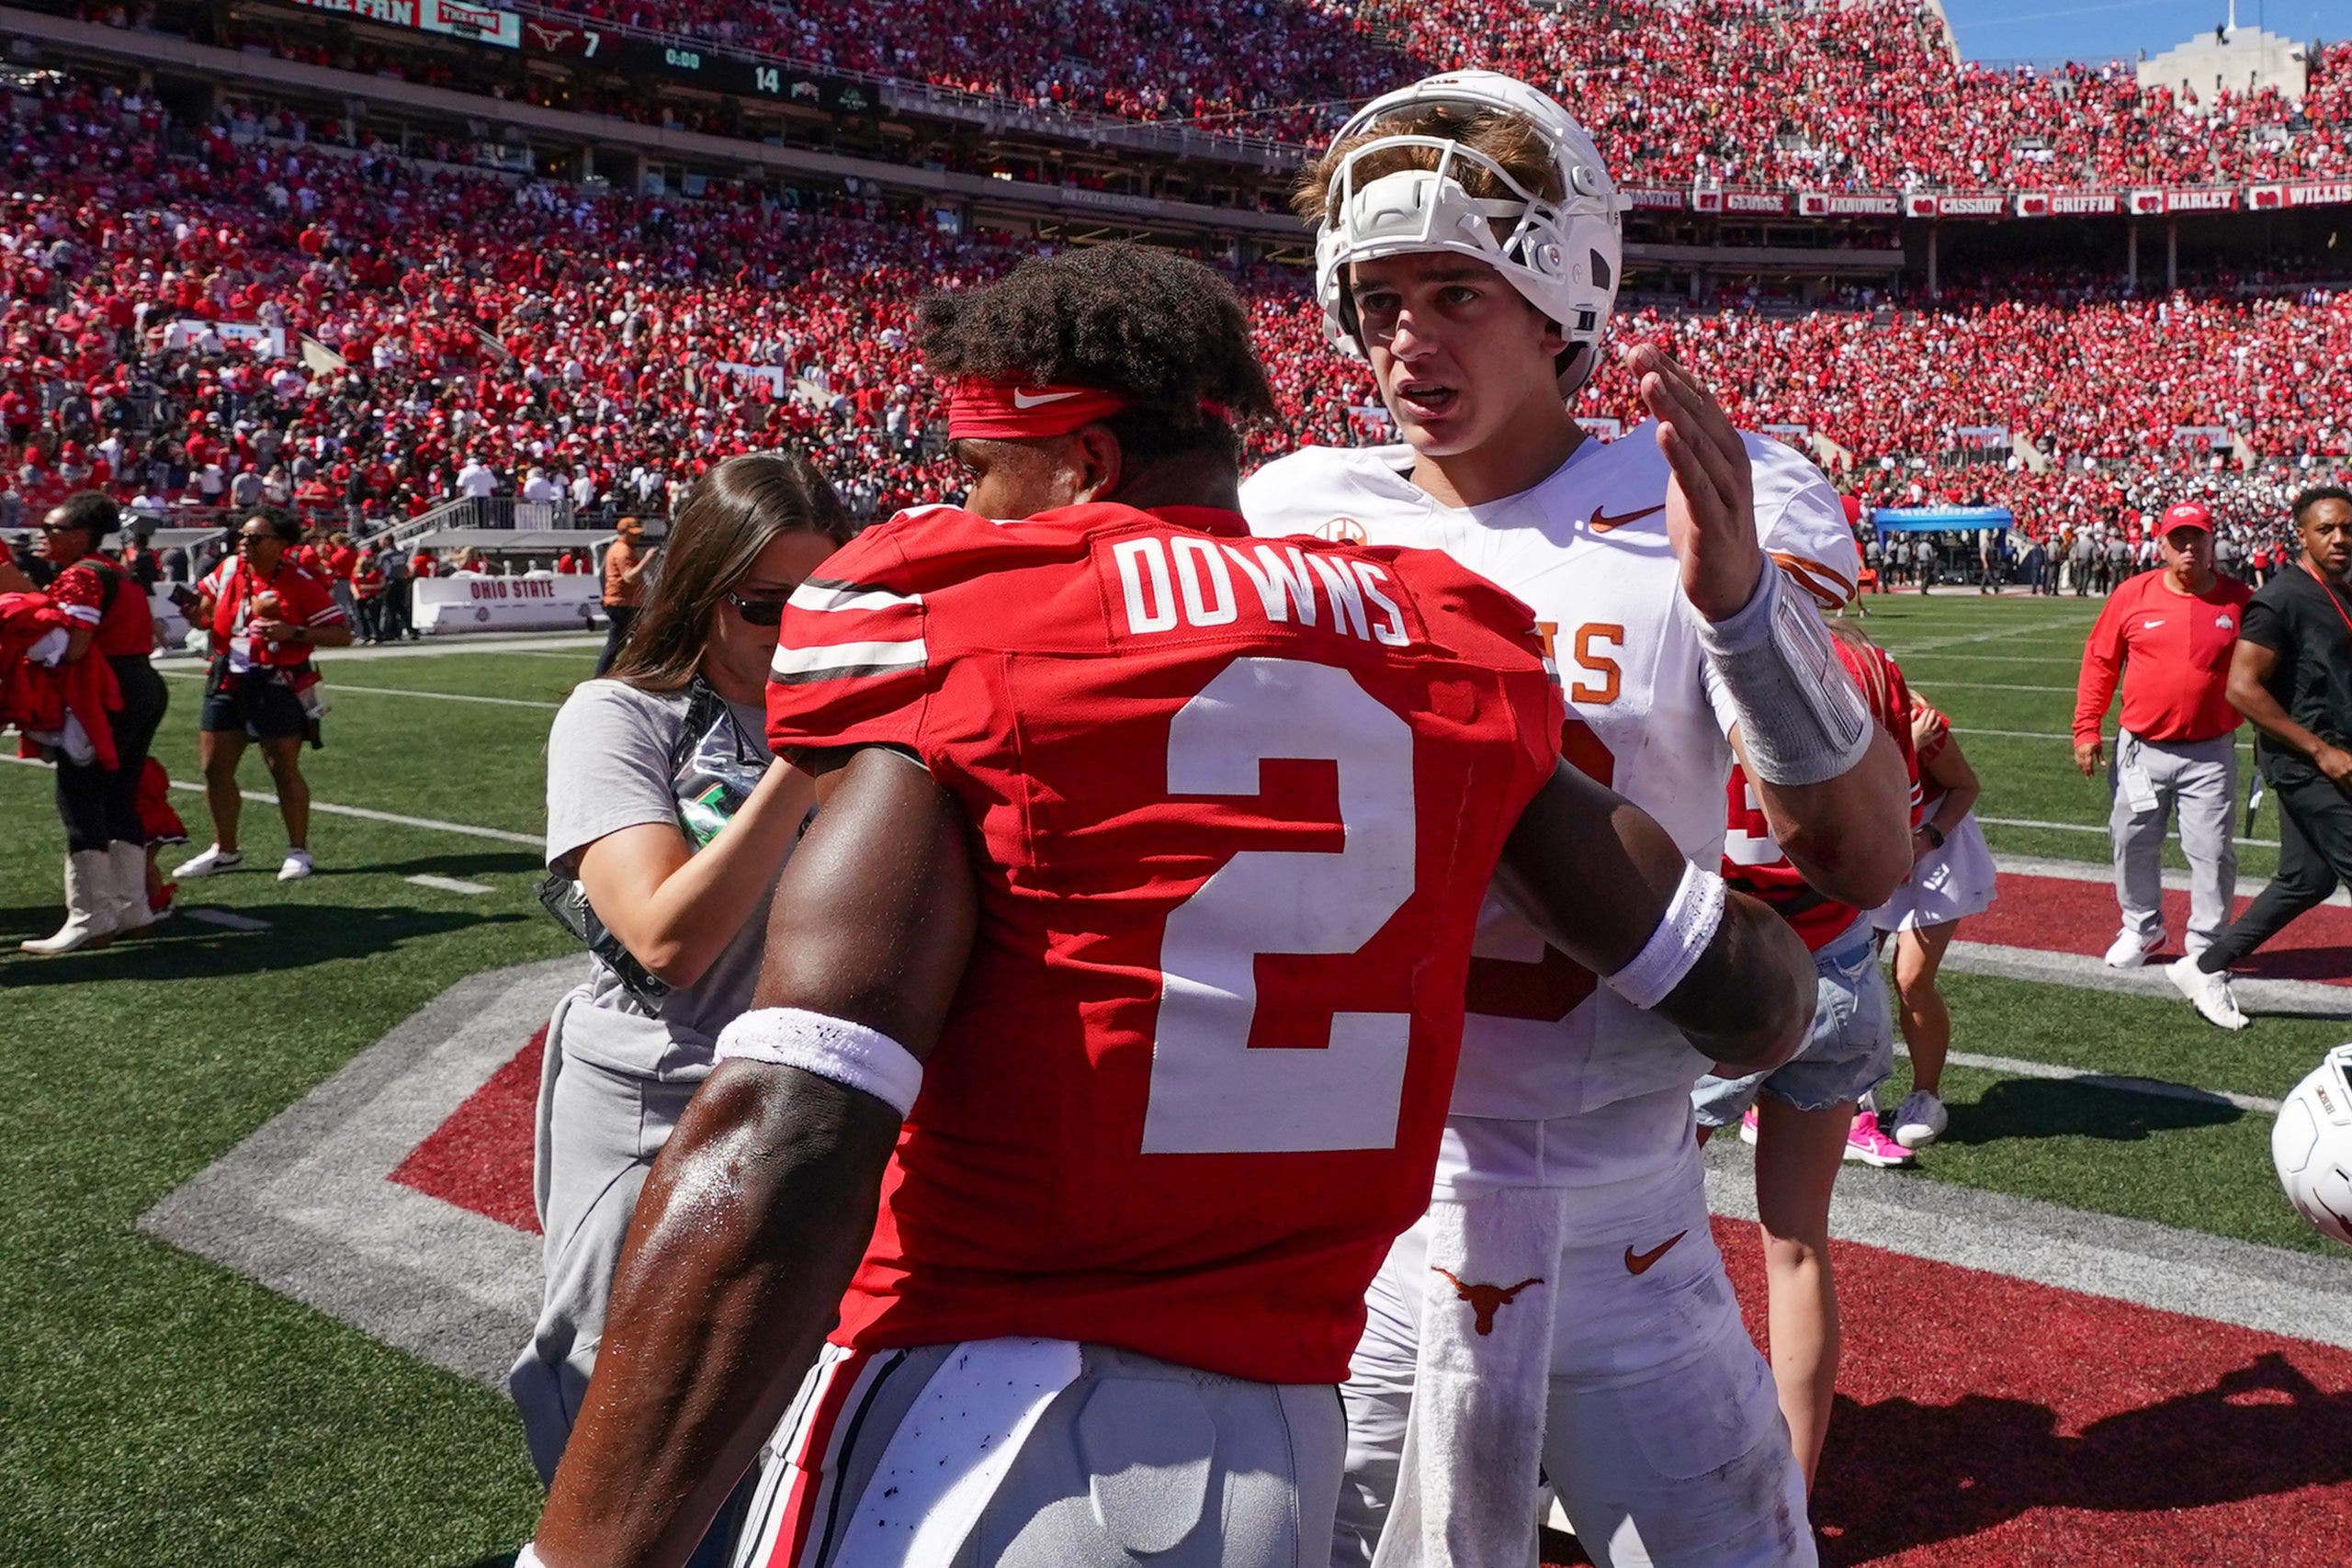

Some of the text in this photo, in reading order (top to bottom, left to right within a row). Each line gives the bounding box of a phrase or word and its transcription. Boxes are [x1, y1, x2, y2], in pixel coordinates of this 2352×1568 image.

[583, 30, 600, 57] 7
[755, 66, 779, 93] 14
[1700, 194, 1784, 211] 27 GEORGE
[2052, 196, 2116, 213] GRIFFIN
[2167, 191, 2233, 210] HARLEY
[2290, 185, 2352, 204] WILLIS
[1940, 197, 2004, 213] CASSADY
[470, 579, 555, 600] OHIO STATE
[1113, 536, 1411, 647] DOWNS
[1140, 657, 1417, 1155] 2
